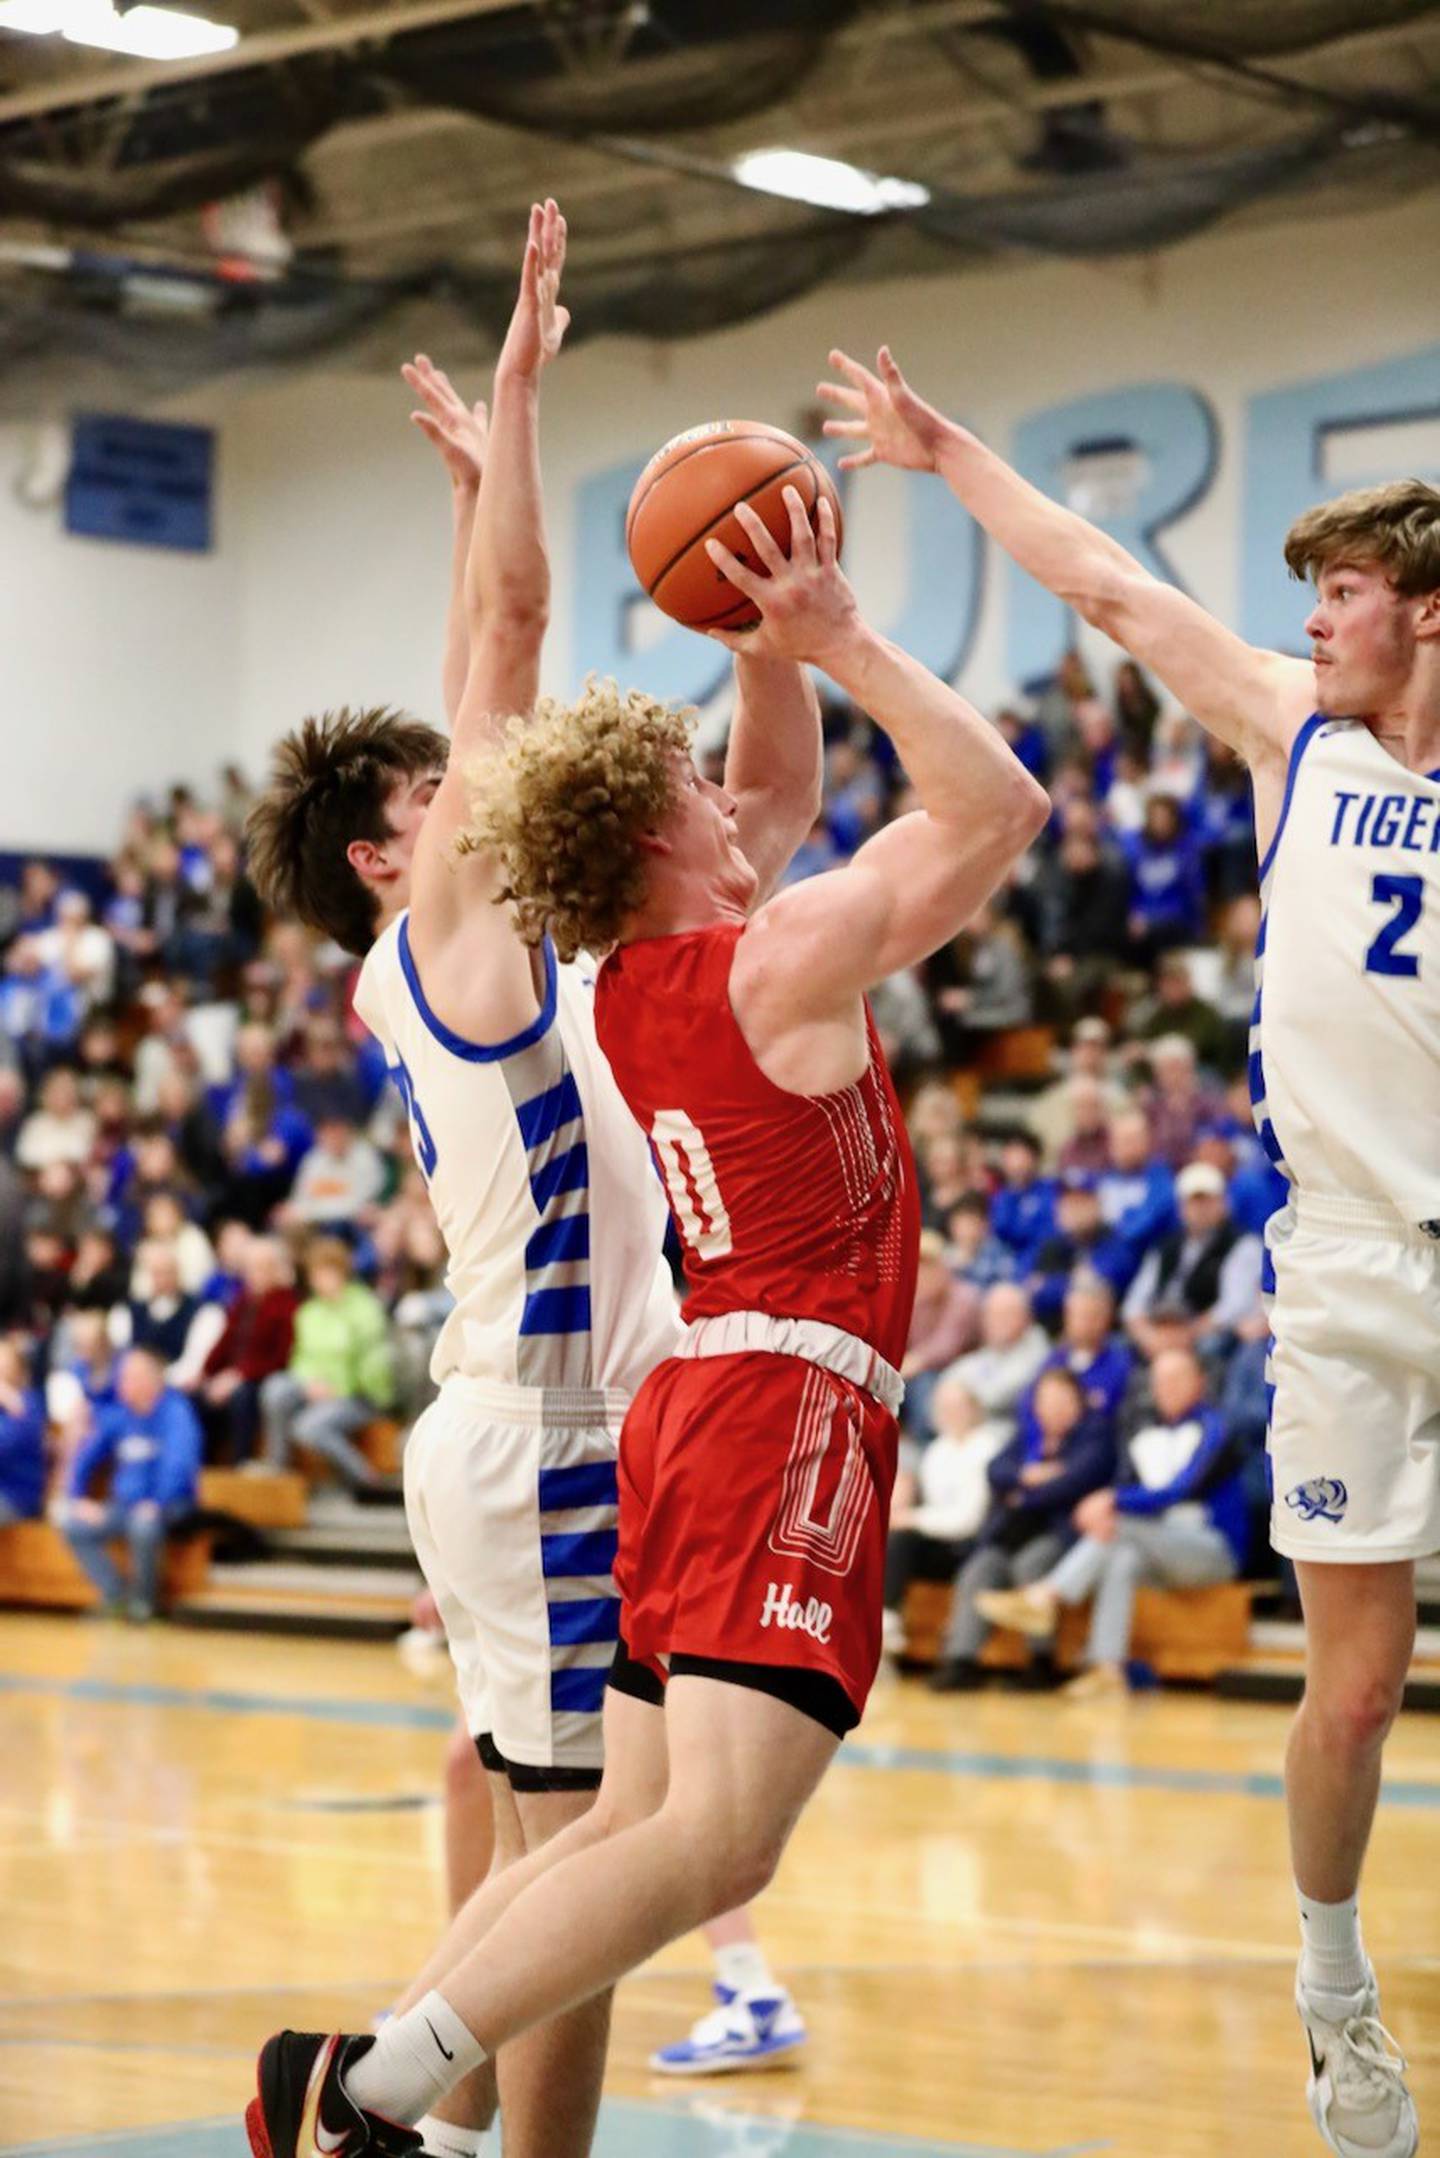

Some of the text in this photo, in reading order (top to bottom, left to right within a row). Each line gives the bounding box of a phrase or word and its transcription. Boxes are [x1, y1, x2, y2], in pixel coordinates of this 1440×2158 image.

[1364, 874, 1425, 976] 2
[650, 1108, 734, 1261] 0
[760, 1583, 833, 1644] Hall
